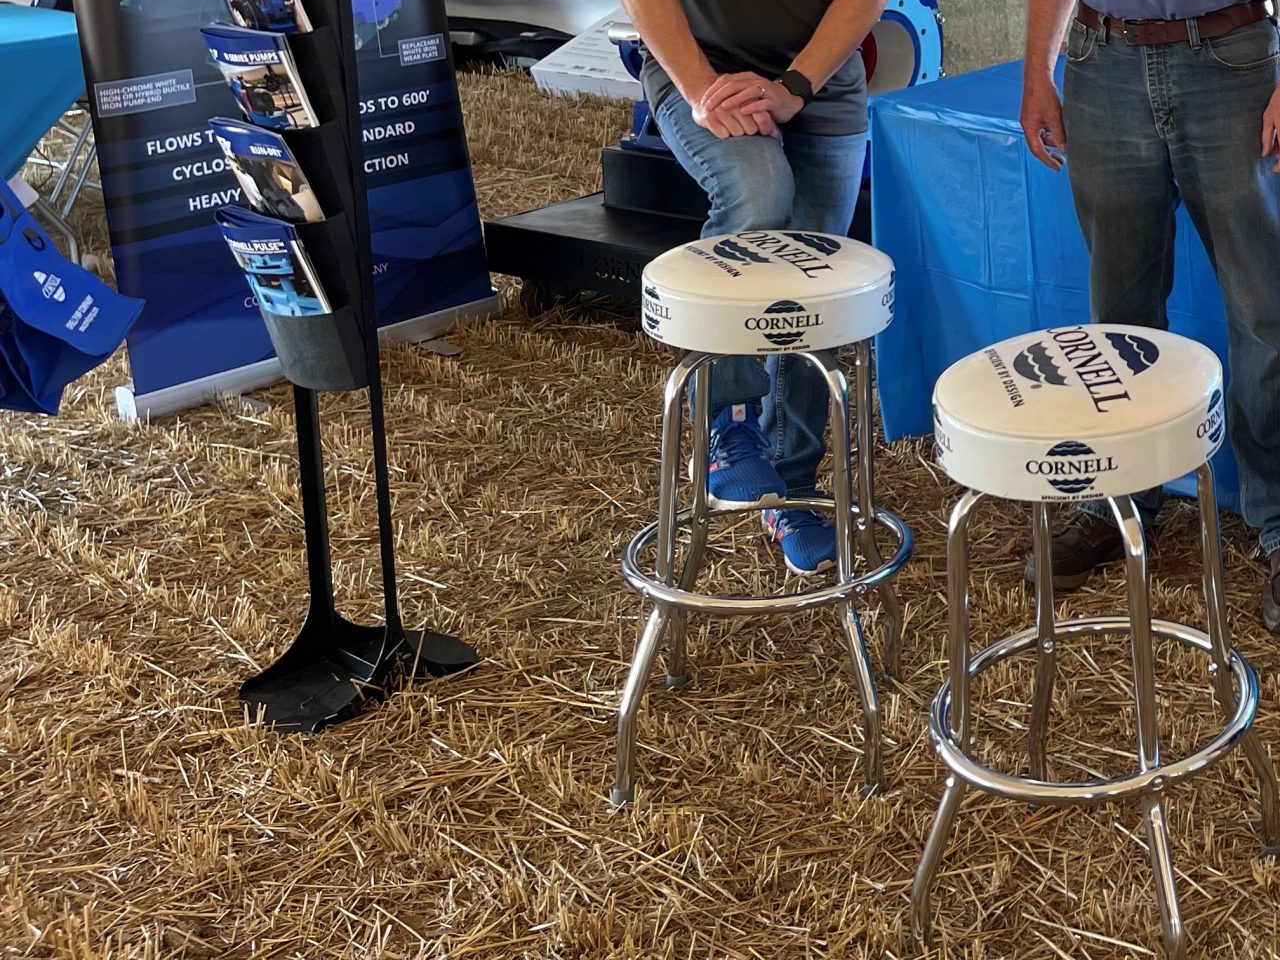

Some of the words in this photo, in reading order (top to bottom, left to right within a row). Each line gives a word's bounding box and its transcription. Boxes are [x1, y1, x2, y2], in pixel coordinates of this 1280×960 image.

[146, 131, 203, 156] FLOWS
[205, 129, 215, 144] T
[378, 95, 399, 111] TO
[172, 158, 232, 181] CYCLOS
[363, 121, 416, 142] NDARD
[188, 188, 241, 212] HEAVY
[364, 152, 410, 173] CTION
[736, 231, 834, 279] ORNELL
[744, 313, 824, 331] CORNELL
[997, 368, 1009, 380] BY
[1002, 379, 1025, 408] DESIGN
[1025, 456, 1119, 475] CORNELL
